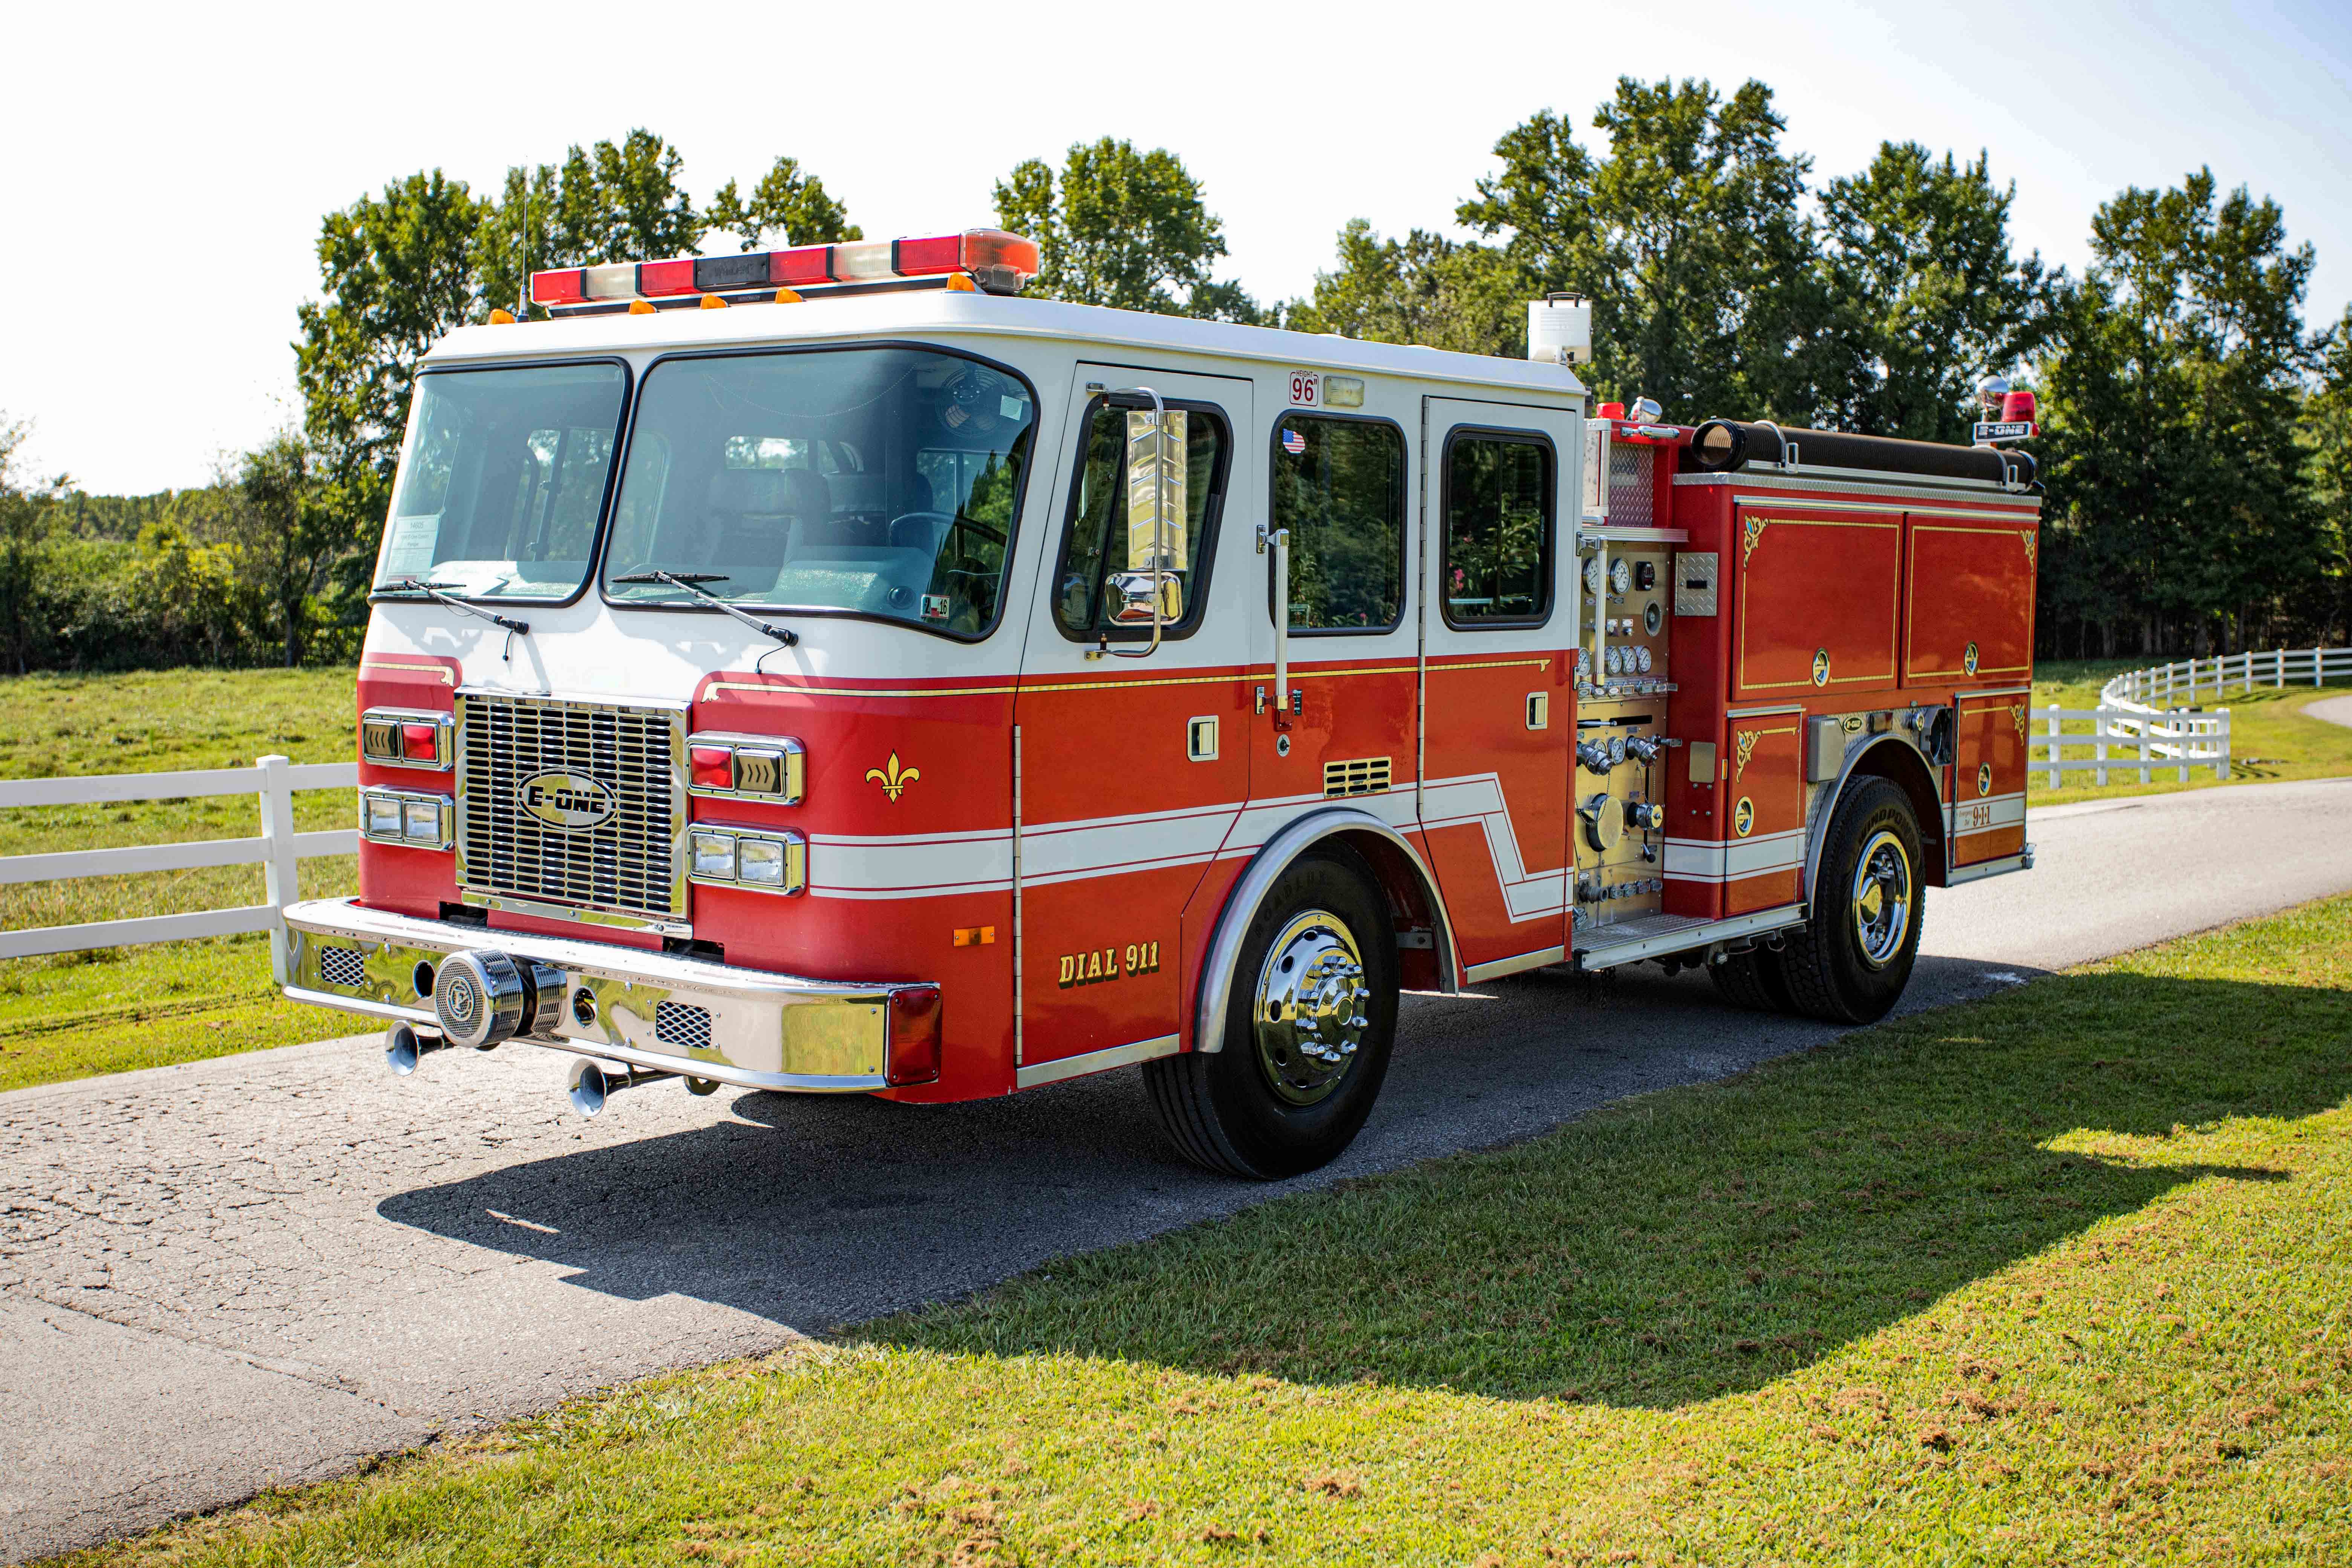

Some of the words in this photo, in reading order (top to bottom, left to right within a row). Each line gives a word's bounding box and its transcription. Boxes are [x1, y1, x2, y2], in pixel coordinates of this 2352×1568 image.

[1296, 369, 1313, 378] HEIGHT
[940, 599, 947, 614] 16
[528, 786, 606, 814] E-ONE
[1059, 948, 1119, 987] DIAL
[1125, 940, 1159, 975] 911
